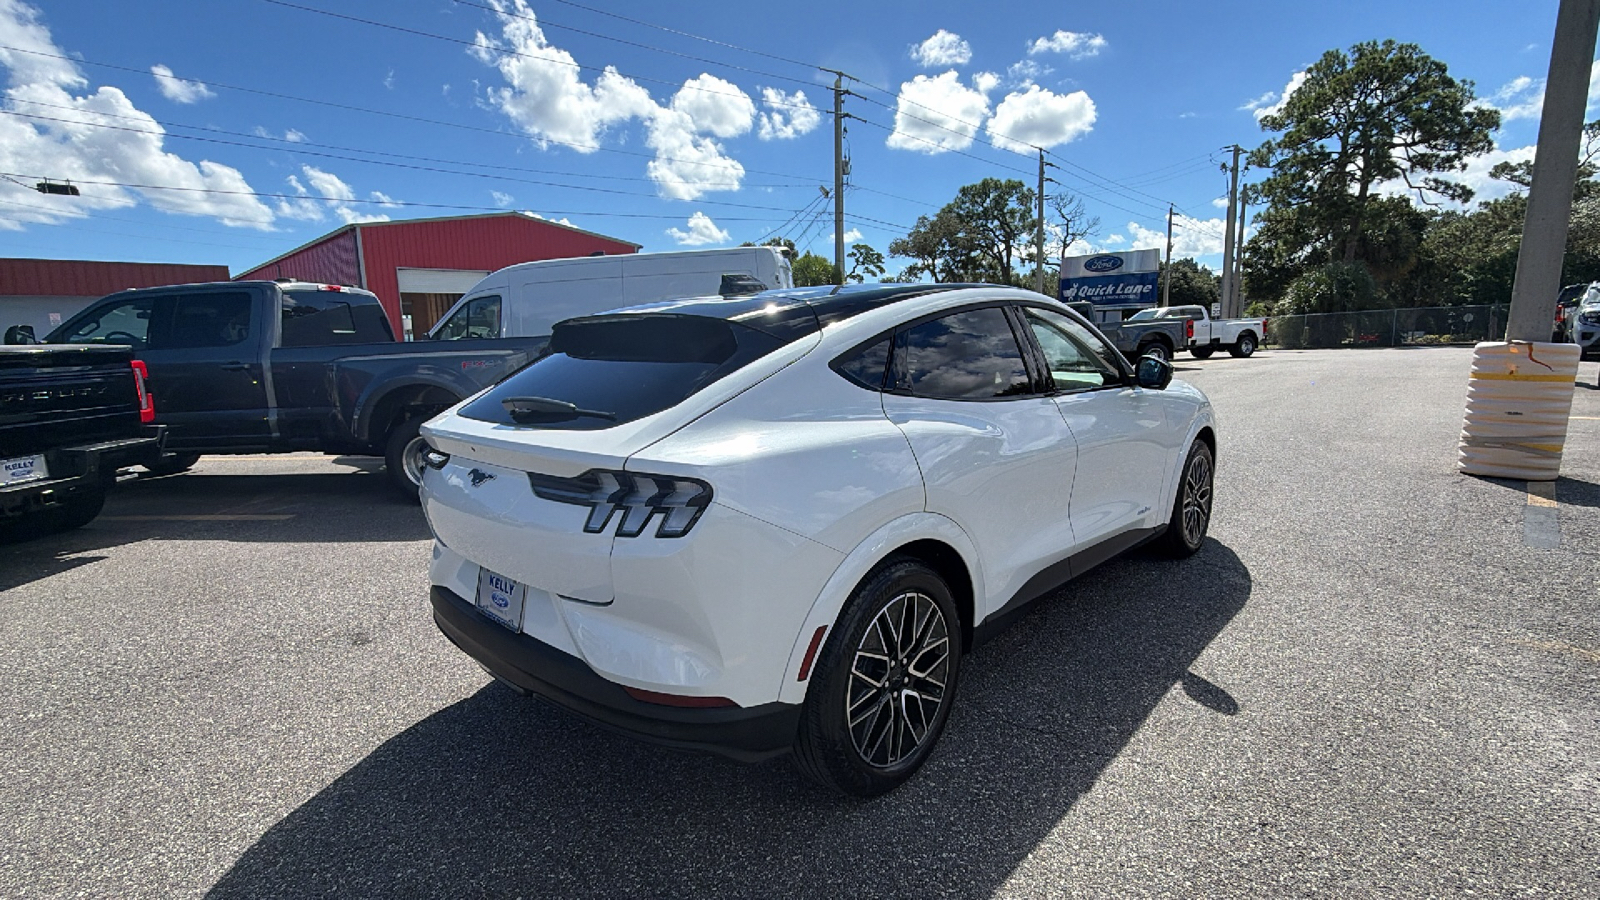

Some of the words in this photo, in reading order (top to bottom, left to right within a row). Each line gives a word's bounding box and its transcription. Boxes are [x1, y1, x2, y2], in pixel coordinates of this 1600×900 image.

[1078, 283, 1115, 298] Quick
[1116, 283, 1153, 295] Lane
[32, 387, 108, 400] DUTY
[4, 460, 34, 471] KELLY
[489, 574, 515, 595] KELLY
